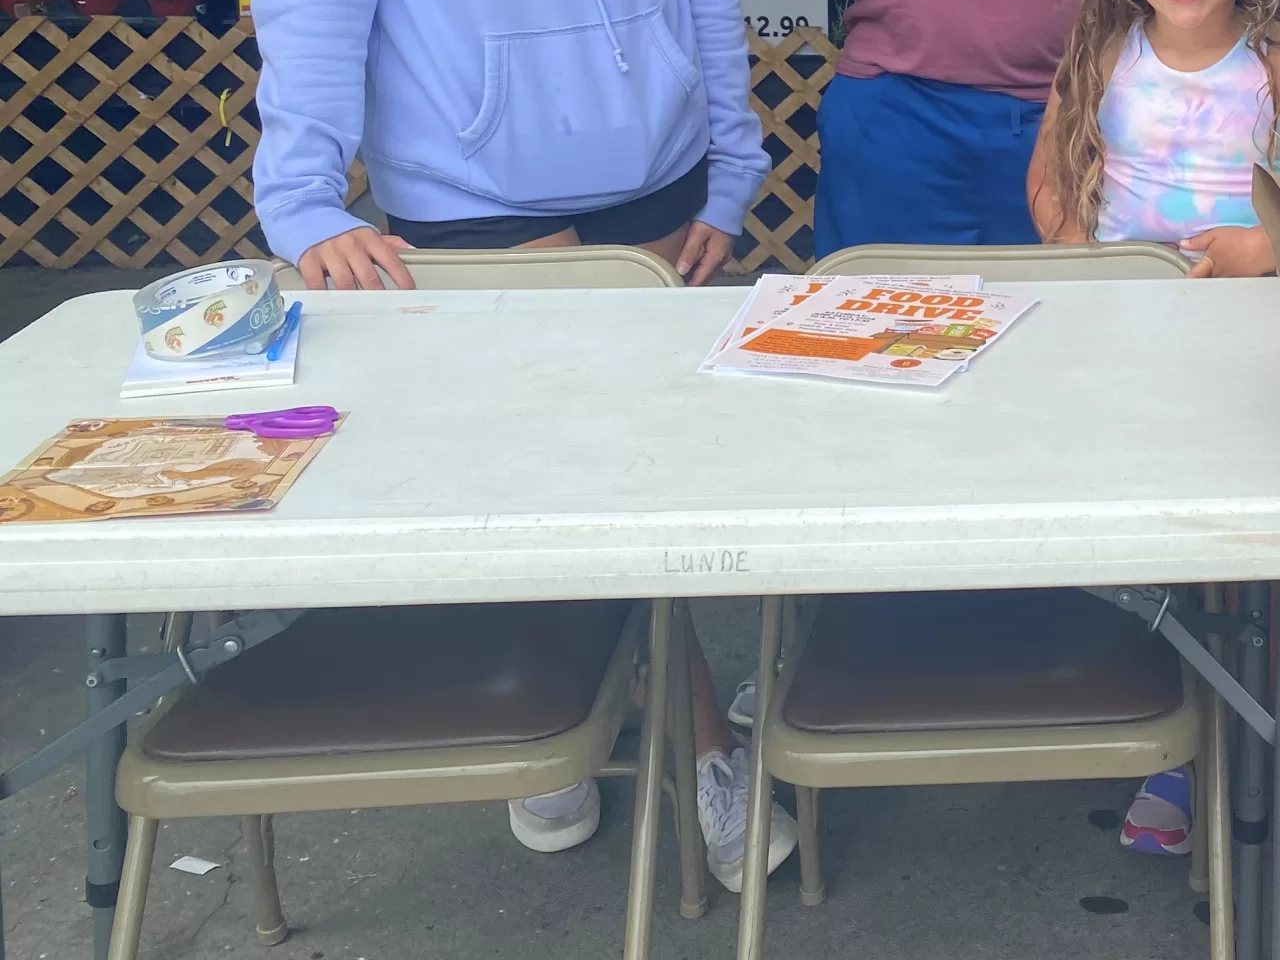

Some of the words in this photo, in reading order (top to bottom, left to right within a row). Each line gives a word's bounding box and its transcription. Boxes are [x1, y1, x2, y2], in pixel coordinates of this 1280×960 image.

[861, 288, 985, 308] FOOD
[835, 299, 984, 321] DRIVE
[663, 550, 751, 575] LUNDE
